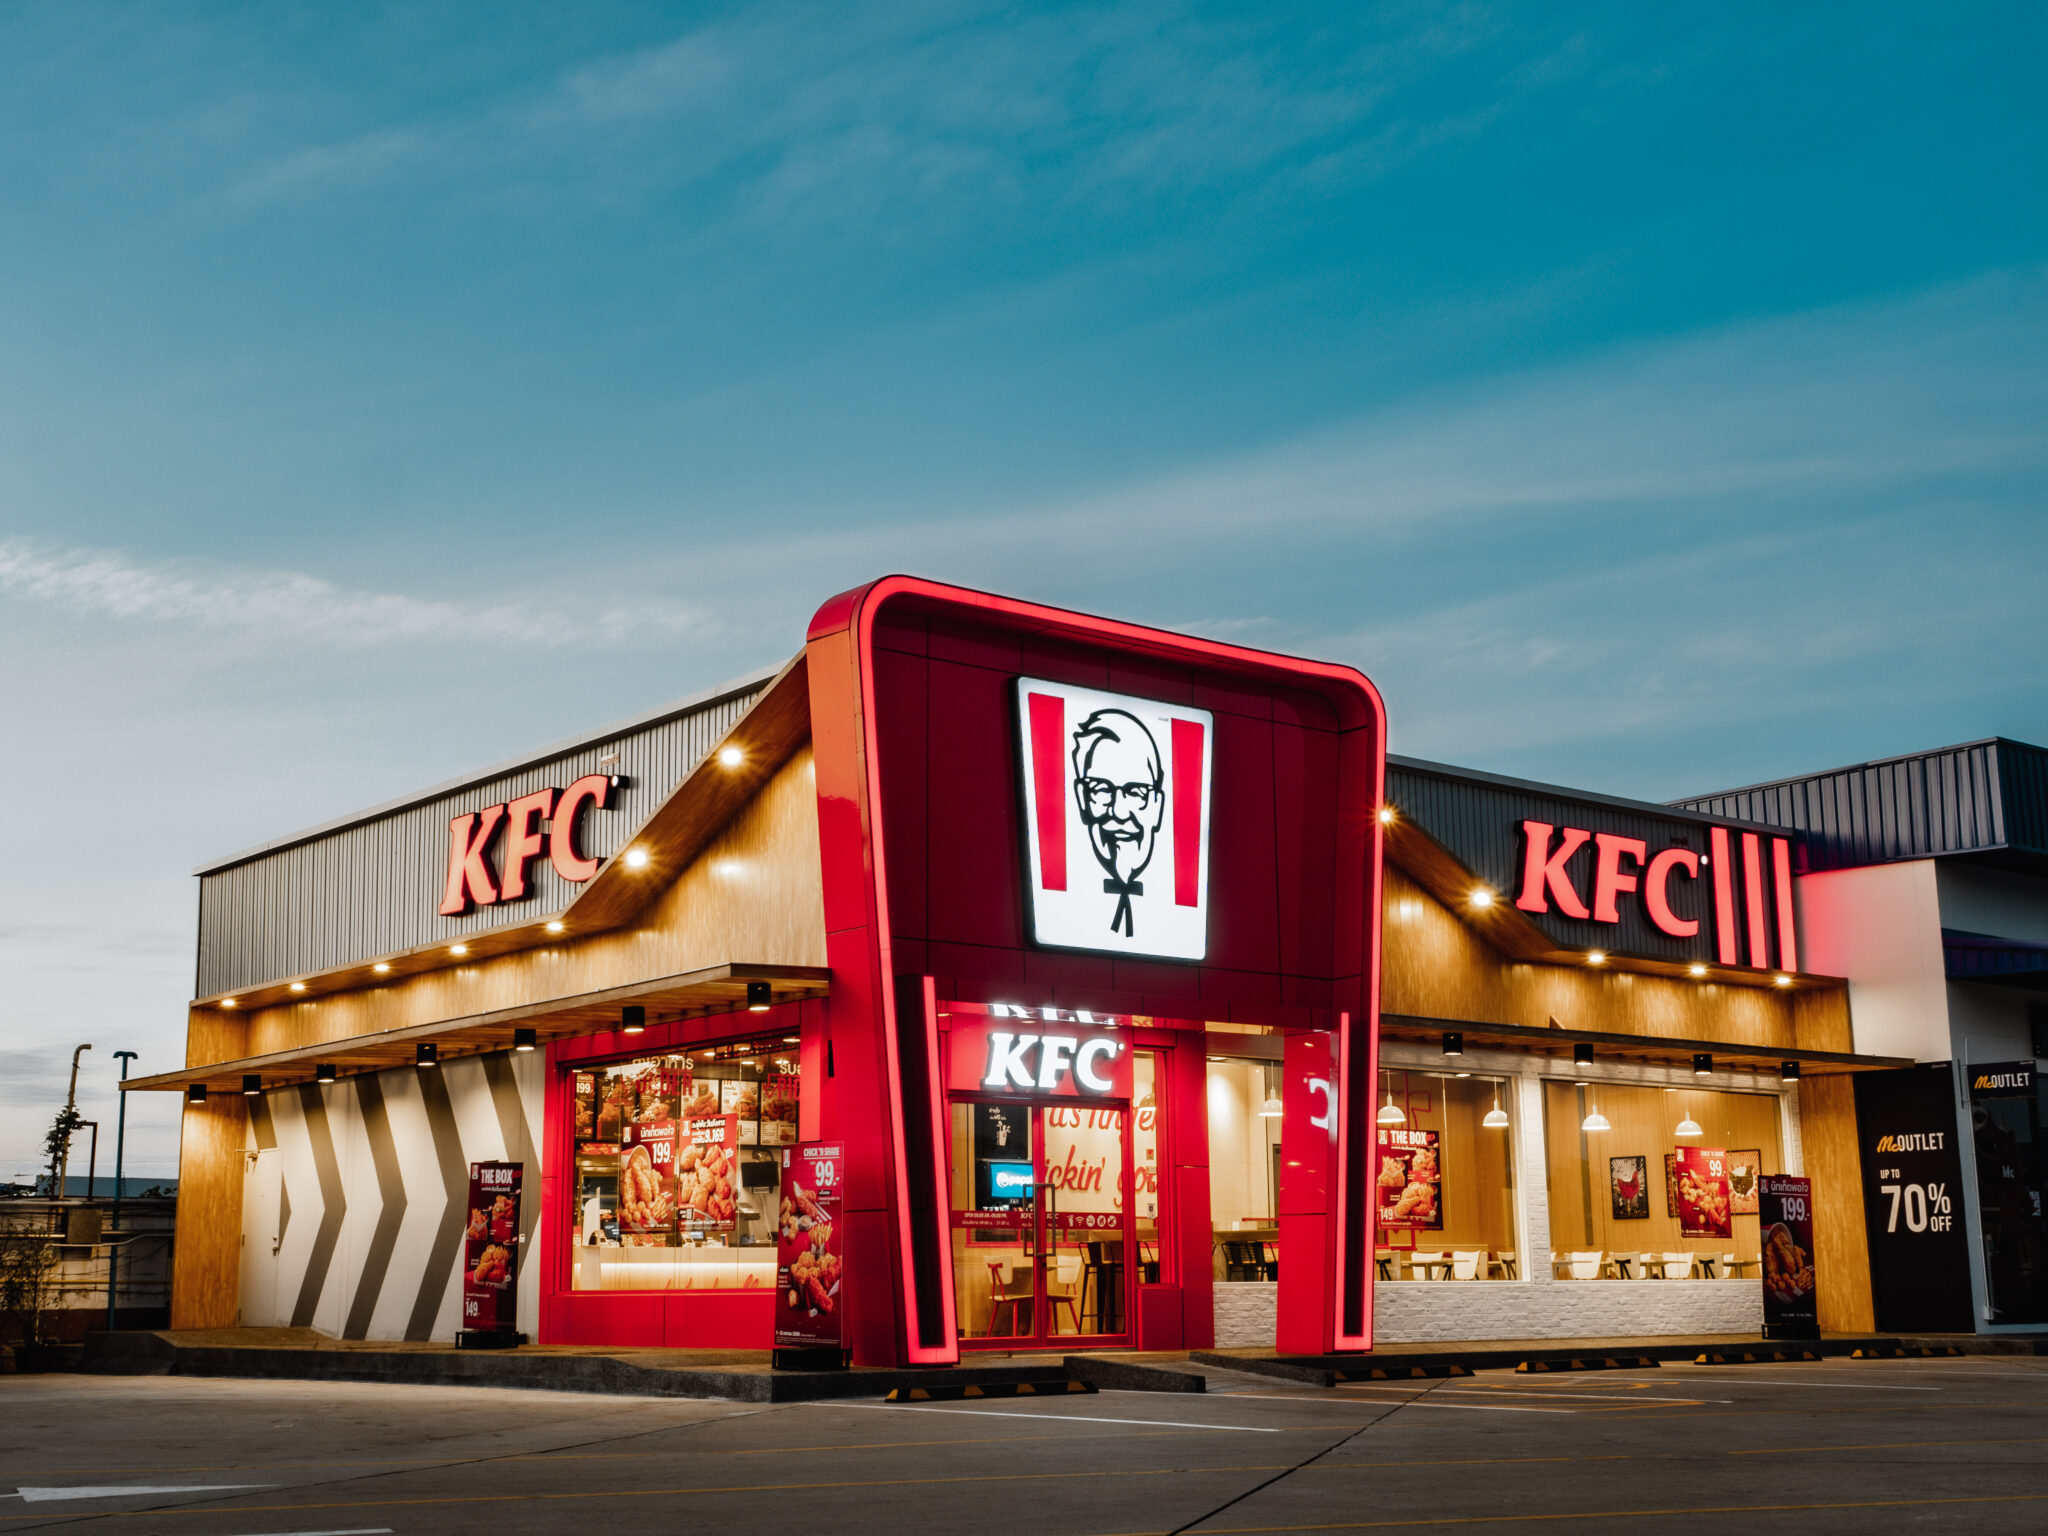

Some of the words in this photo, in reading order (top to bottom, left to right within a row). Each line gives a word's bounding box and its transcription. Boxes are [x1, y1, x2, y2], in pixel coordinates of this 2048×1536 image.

[439, 774, 609, 915] KFC
[1515, 819, 1699, 938] KFC
[984, 1032, 1118, 1091] KFC
[1390, 1130, 1408, 1145] THE
[1409, 1131, 1428, 1146] BOX
[480, 1168, 495, 1184] THE
[495, 1168, 513, 1185] BOX
[1880, 1169, 1890, 1180] UP
[1891, 1169, 1901, 1180] TO
[1930, 1216, 1952, 1232] OFF
